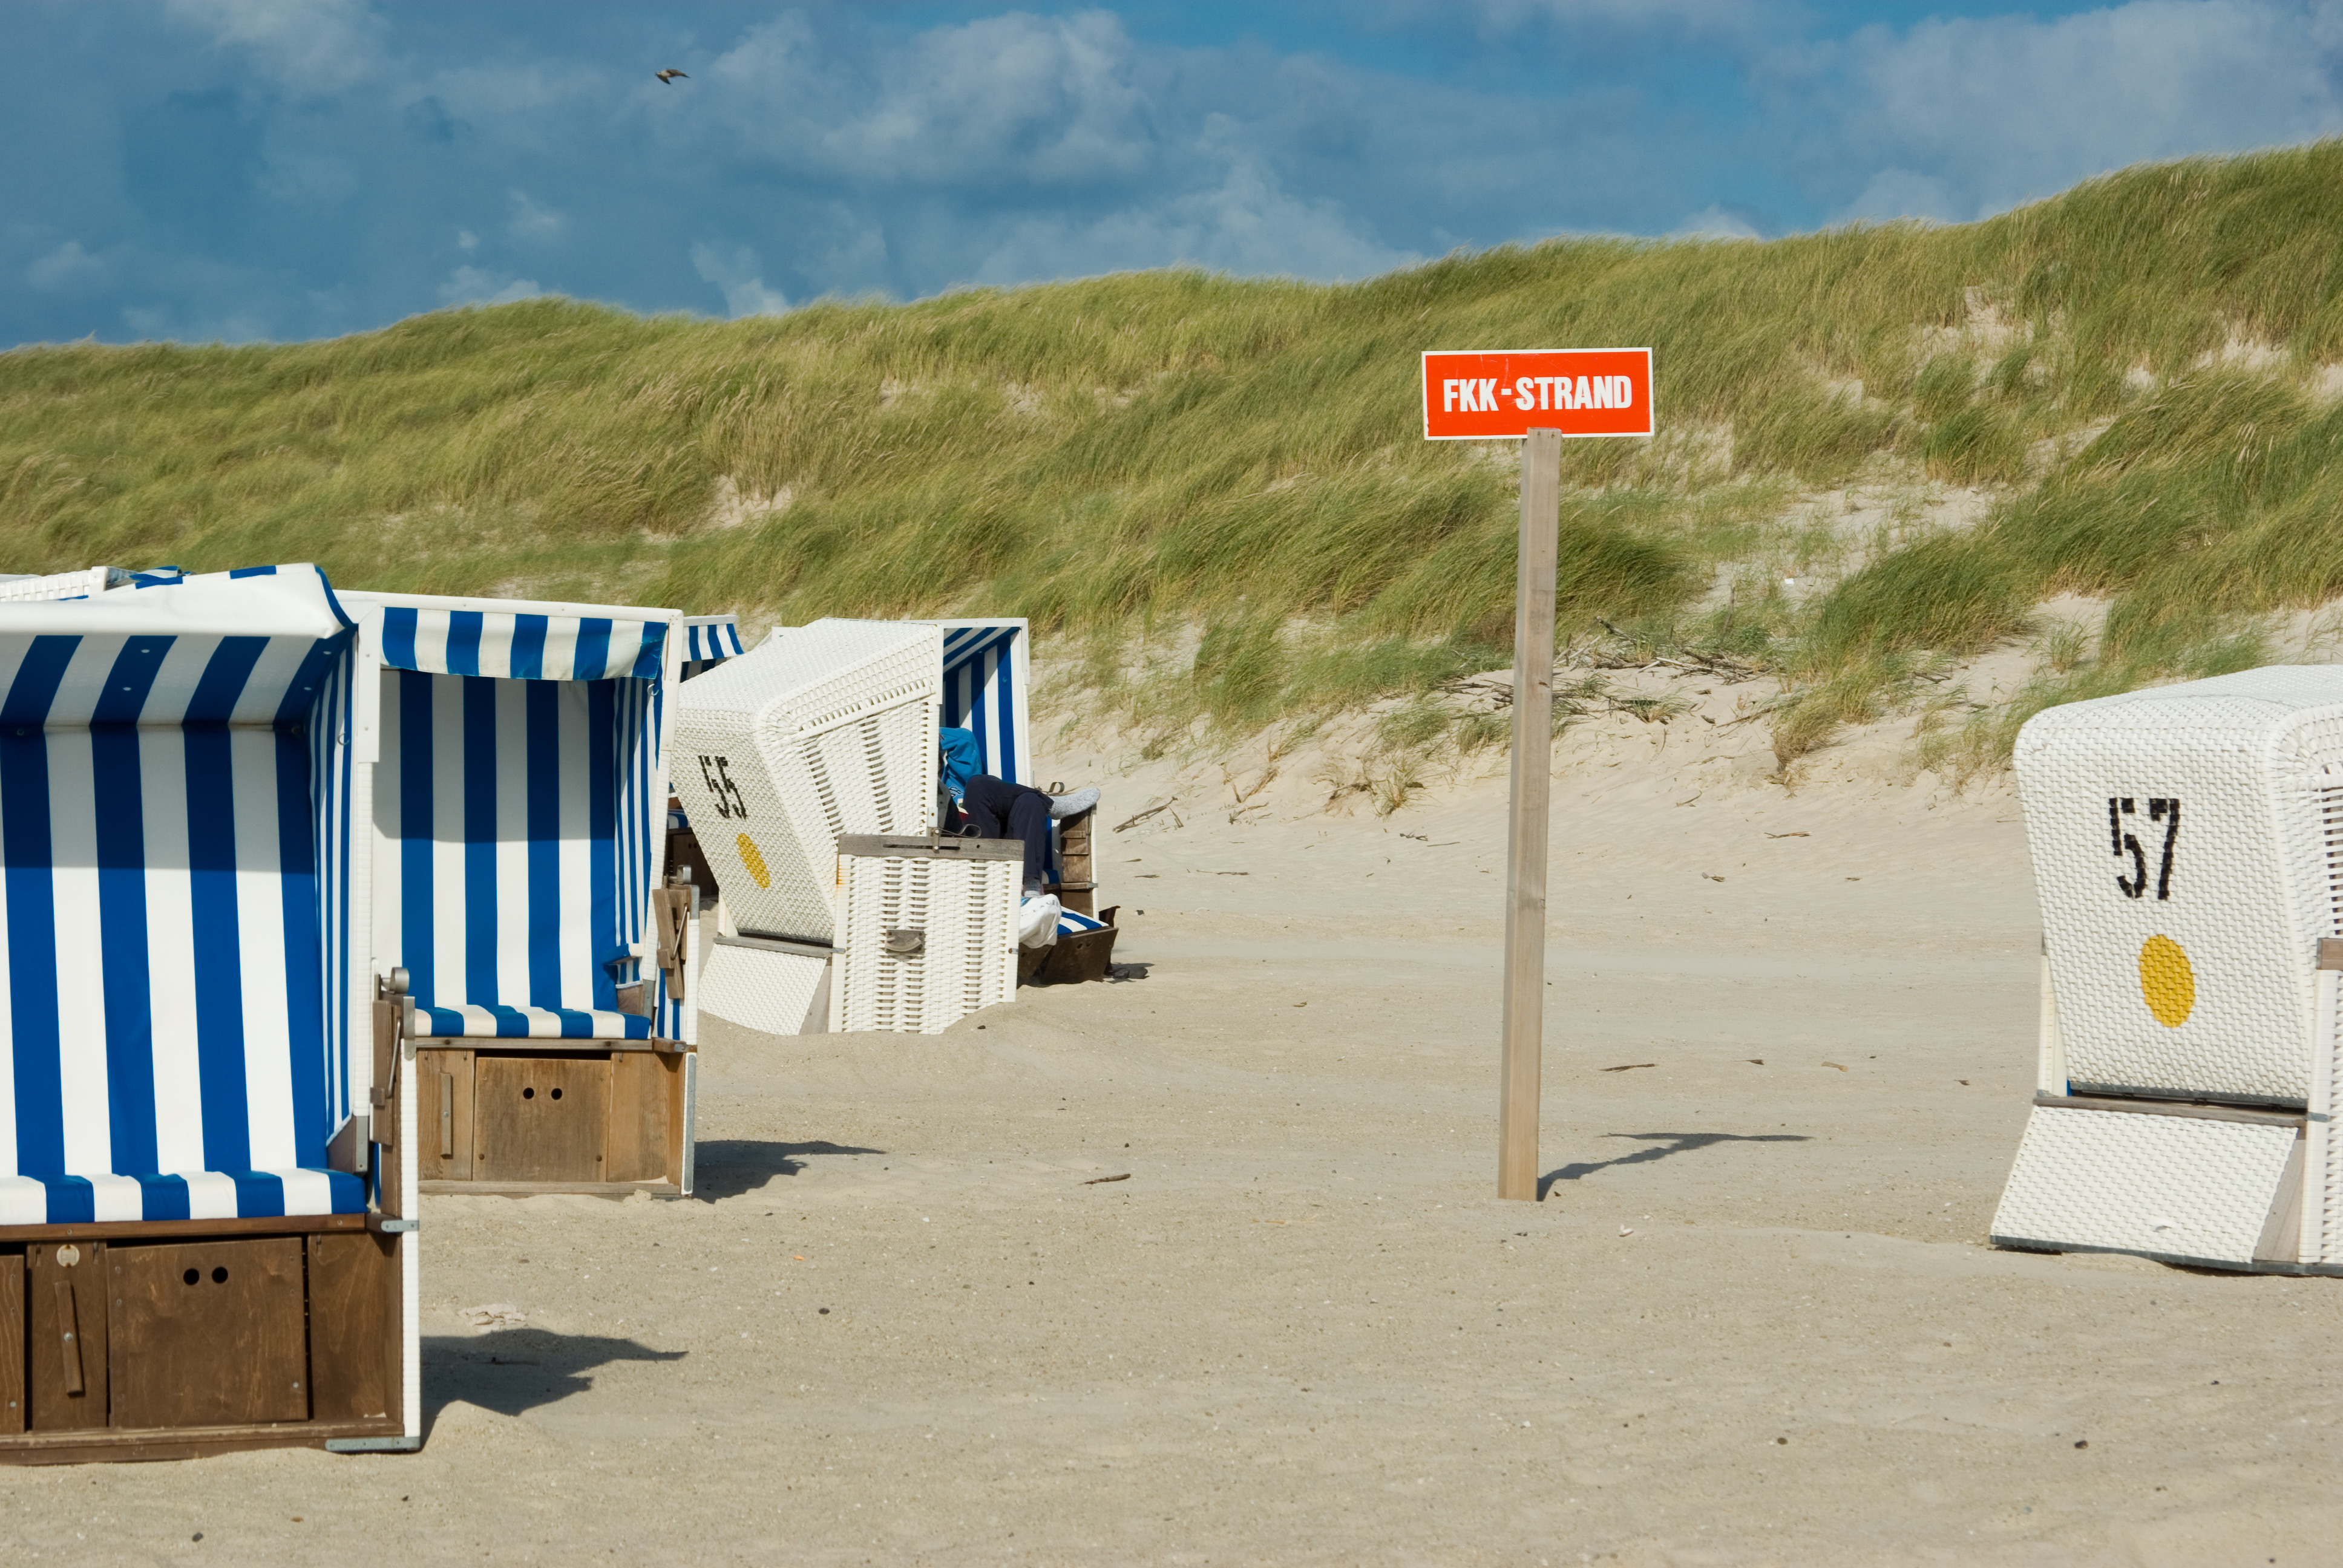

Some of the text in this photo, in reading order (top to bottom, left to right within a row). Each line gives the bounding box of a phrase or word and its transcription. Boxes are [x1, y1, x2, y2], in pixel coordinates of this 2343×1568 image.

[1443, 375, 1633, 412] FKK-STRAND
[698, 756, 747, 820] 55
[2109, 797, 2180, 900] 57
